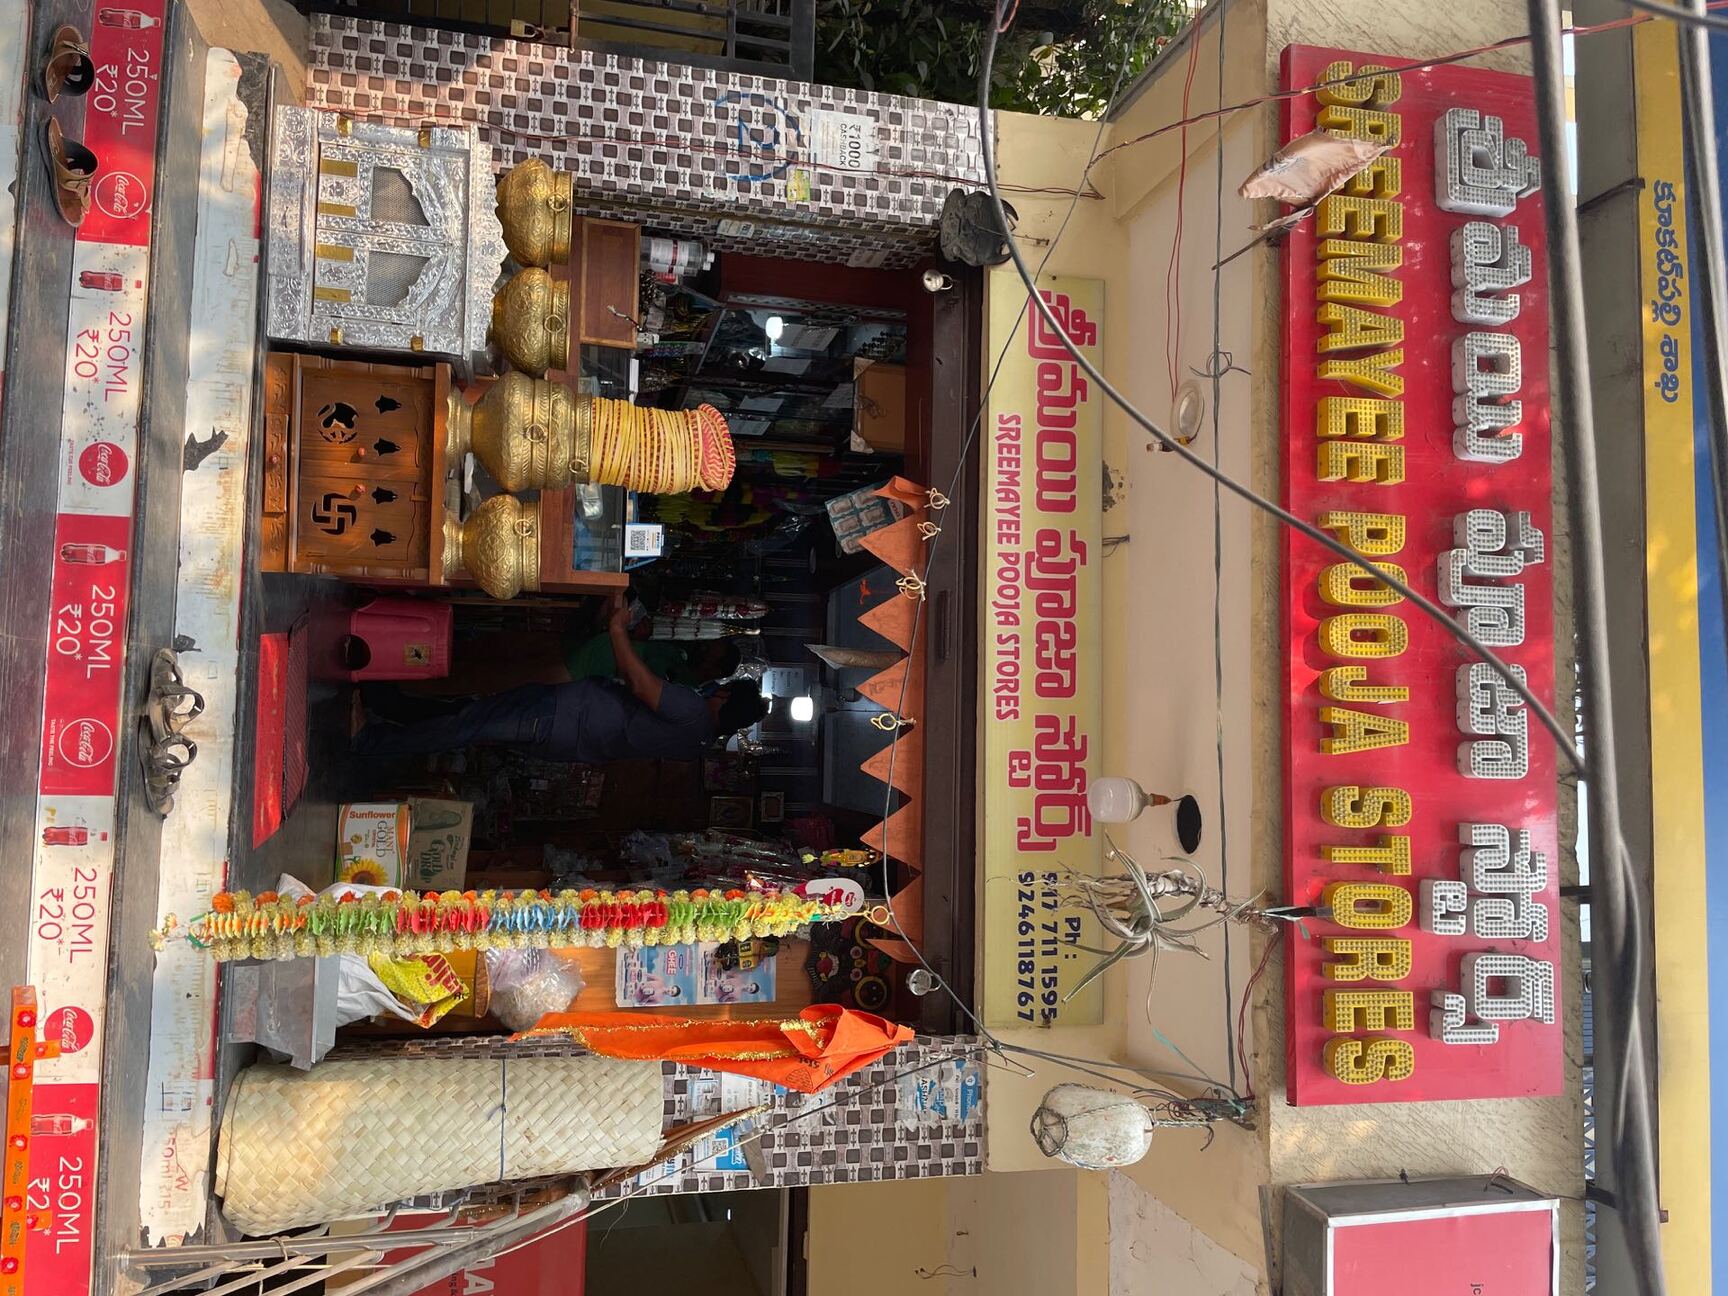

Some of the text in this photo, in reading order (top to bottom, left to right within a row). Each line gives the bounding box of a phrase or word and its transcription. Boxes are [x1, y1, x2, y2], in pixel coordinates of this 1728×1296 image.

[122, 48, 150, 135] 250ML
[839, 123, 847, 166] CASHBACK
[848, 124, 861, 168] ₹1000
[113, 175, 129, 214] Coca-Cola
[104, 311, 132, 402] 250ML
[1654, 334, 1679, 403] శాఖ
[96, 444, 112, 485] Coca-Cola
[992, 414, 1021, 721] SREEMAYEE POOJA STORES
[87, 584, 115, 679] 250ML
[1024, 529, 1087, 699] పూజా
[1318, 510, 1410, 755] POOJA
[1437, 509, 1544, 779] పూజా
[78, 722, 95, 764] Coca-Cola
[349, 811, 396, 819] Sunflower
[376, 820, 387, 858] GOLD
[69, 867, 97, 964] 250ML
[1018, 871, 1035, 1021] 9246118767
[1041, 921, 1058, 956] 711
[1320, 786, 1415, 1084] STORES
[667, 950, 677, 976] GHEE
[1041, 965, 1058, 1020] 1595
[61, 1008, 80, 1050] Coca-Cola
[56, 1156, 83, 1255] 250ML
